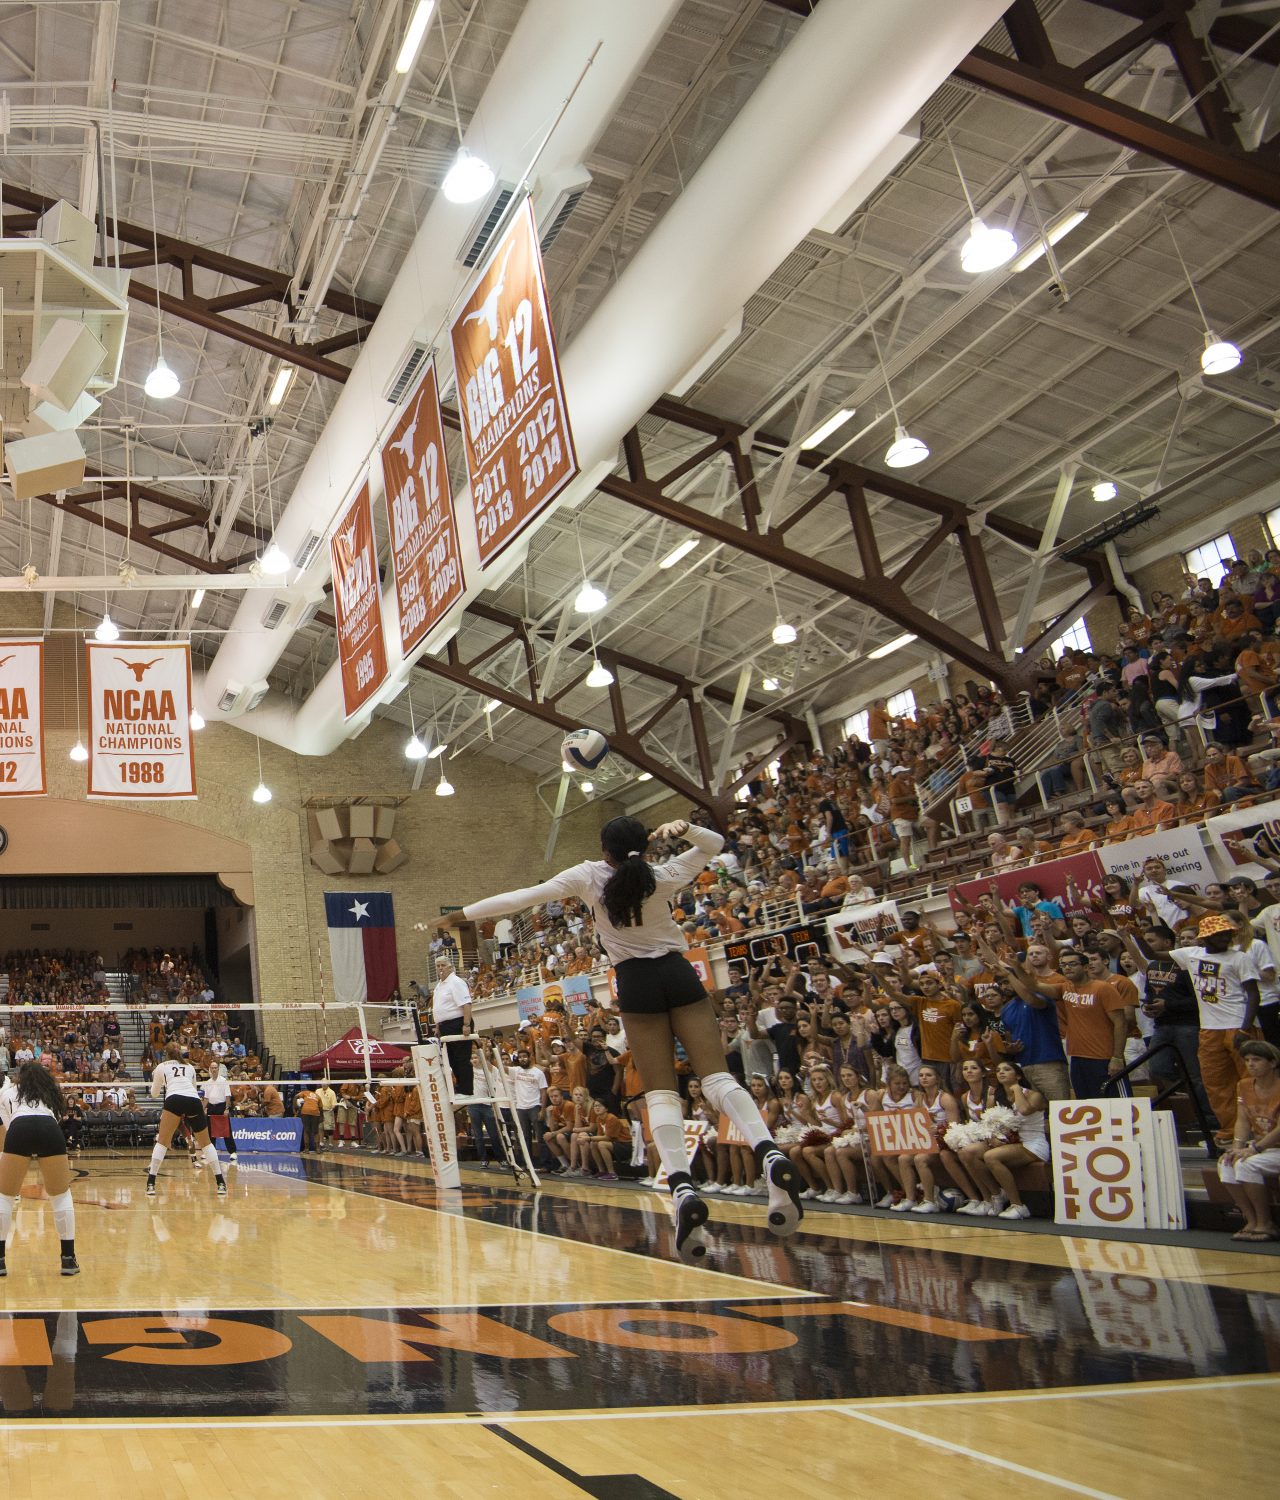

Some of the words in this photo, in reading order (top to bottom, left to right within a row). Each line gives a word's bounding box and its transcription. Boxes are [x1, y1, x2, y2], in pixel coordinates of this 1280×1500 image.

[466, 347, 504, 443] BIG
[504, 298, 538, 386] 12
[474, 366, 540, 465] CHAMPIONS
[517, 398, 557, 466] 2012
[474, 456, 507, 514] 2011
[522, 432, 562, 500] 2014
[392, 475, 419, 553] BIG
[419, 441, 440, 511] 12
[479, 489, 514, 547] 2013
[397, 501, 442, 573] CHAMPIONS
[426, 528, 450, 580] 2007
[340, 545, 371, 622] NCAA
[430, 557, 457, 609] 2009
[401, 595, 427, 641] 2008
[103, 689, 177, 721] NCAA
[106, 722, 175, 735] NATIONAL
[99, 735, 182, 750] CHAMPIONS
[118, 762, 165, 784] 1988
[1110, 863, 1130, 874] Dine
[1131, 860, 1141, 870] in
[1167, 860, 1202, 876] atering
[1172, 848, 1189, 859] out
[858, 925, 899, 946] NETORK
[172, 1066, 186, 1078] 27
[232, 1129, 297, 1140] uthwest.com
[428, 1073, 450, 1162] LONGHORNS
[870, 1111, 932, 1152] TEXAS
[1086, 1147, 1134, 1222] GO
